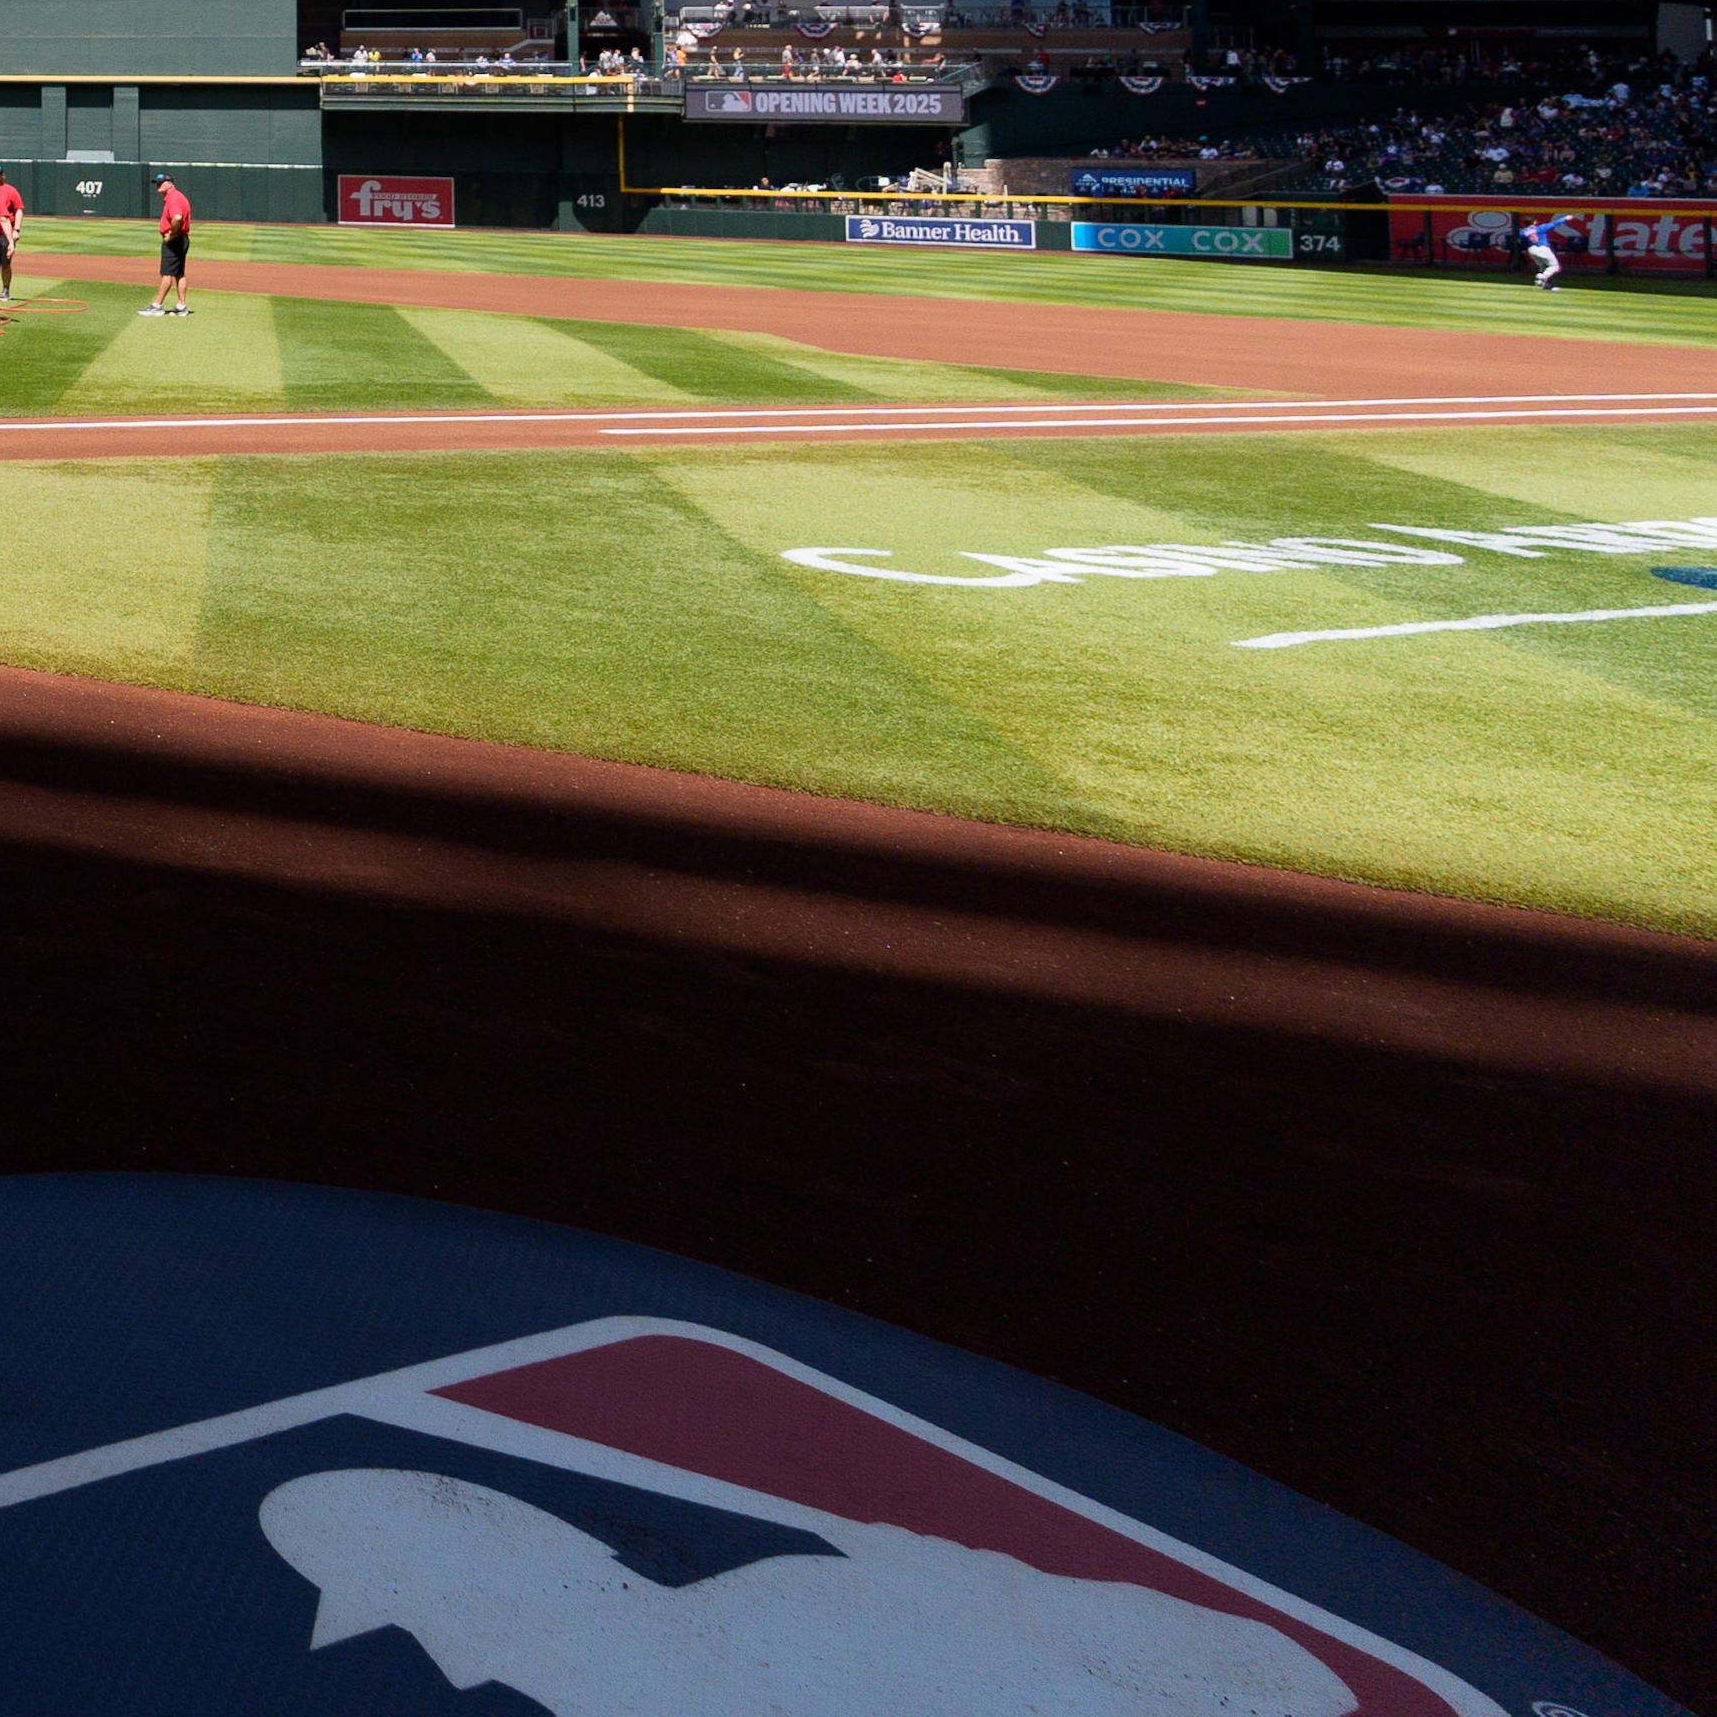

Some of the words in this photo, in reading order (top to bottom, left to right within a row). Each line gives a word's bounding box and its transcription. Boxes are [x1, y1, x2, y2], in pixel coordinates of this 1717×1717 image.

[756, 92, 834, 113] OPENING
[841, 92, 891, 114] WEEK
[893, 93, 941, 115] 2025
[76, 181, 102, 194] 407
[1102, 177, 1190, 187] PRESIDENTIAL
[350, 181, 441, 220] fry's
[578, 195, 604, 208] 413
[883, 222, 951, 241] Banner
[955, 223, 1020, 242] Health
[1098, 229, 1165, 249] COX
[1193, 231, 1264, 252] COX
[1300, 235, 1340, 252] 374
[781, 537, 1463, 588] CASINO
